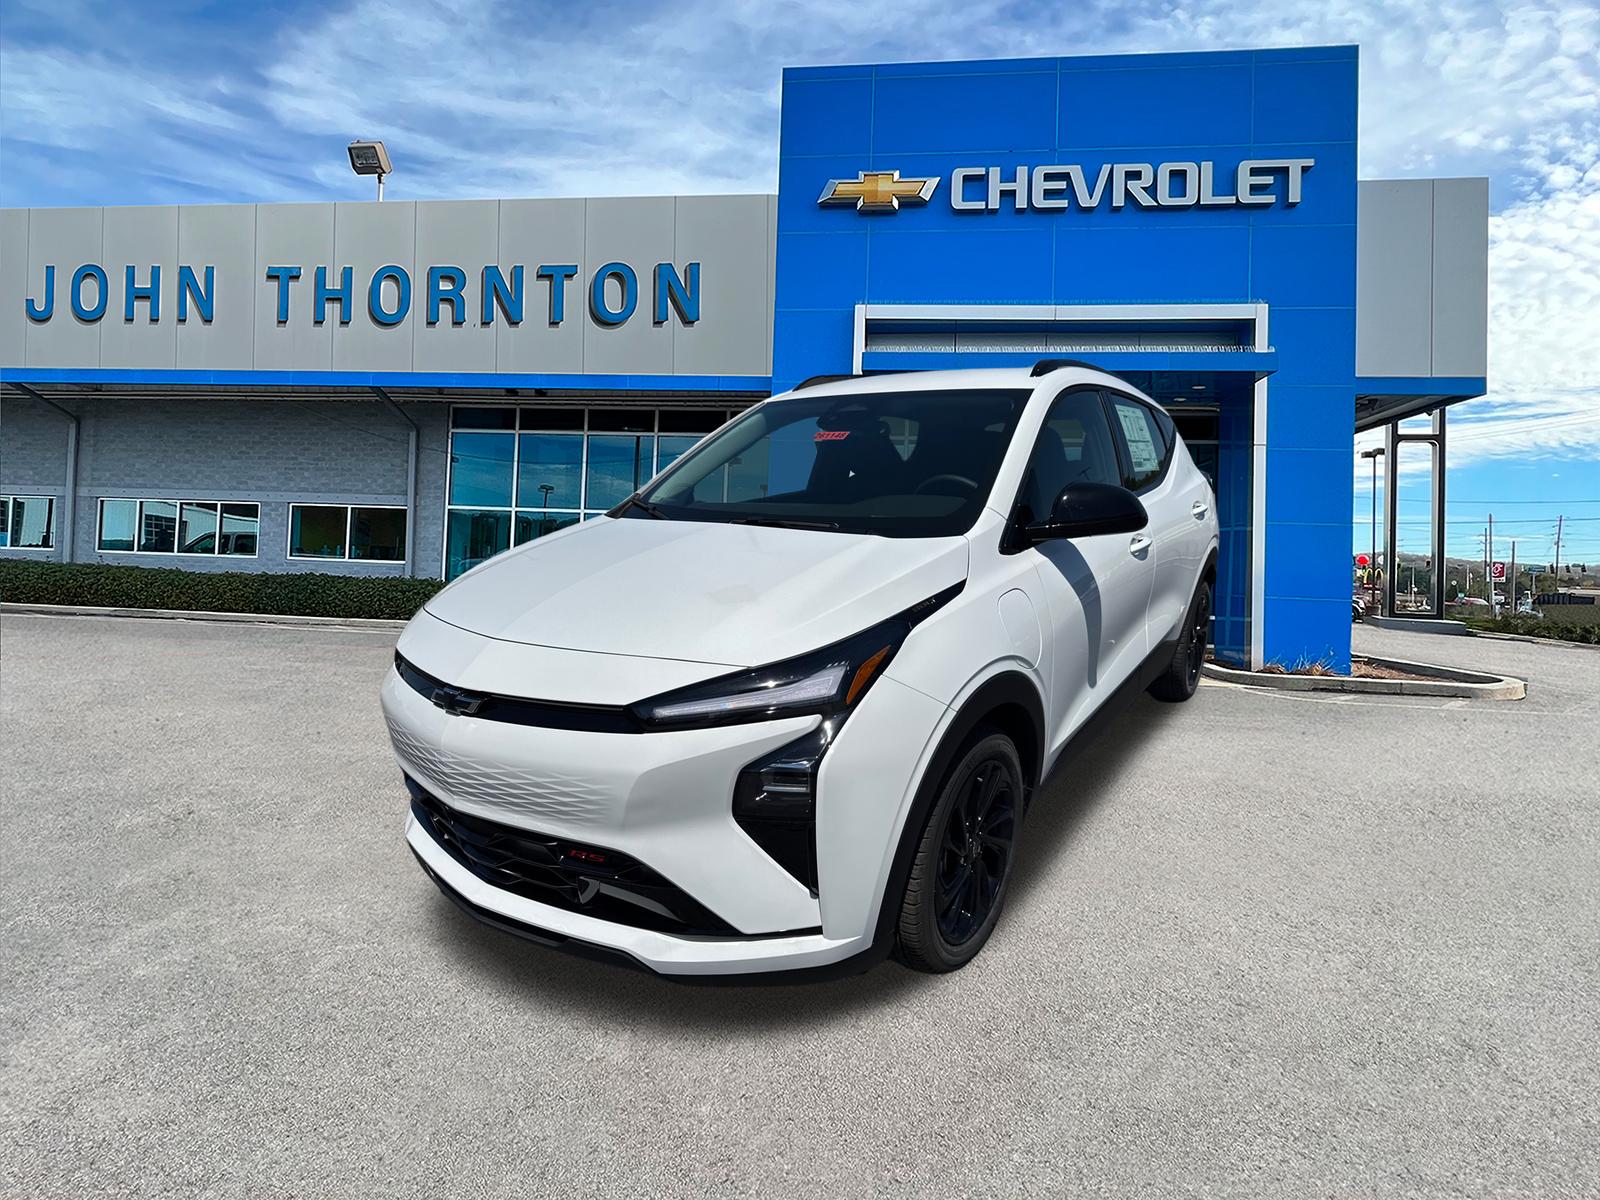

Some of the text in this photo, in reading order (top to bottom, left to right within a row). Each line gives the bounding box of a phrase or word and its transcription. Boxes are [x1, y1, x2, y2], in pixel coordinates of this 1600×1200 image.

[950, 157, 1316, 213] CHEVROLET
[26, 261, 703, 328] JOHN THORNTON
[568, 850, 606, 863] RS
